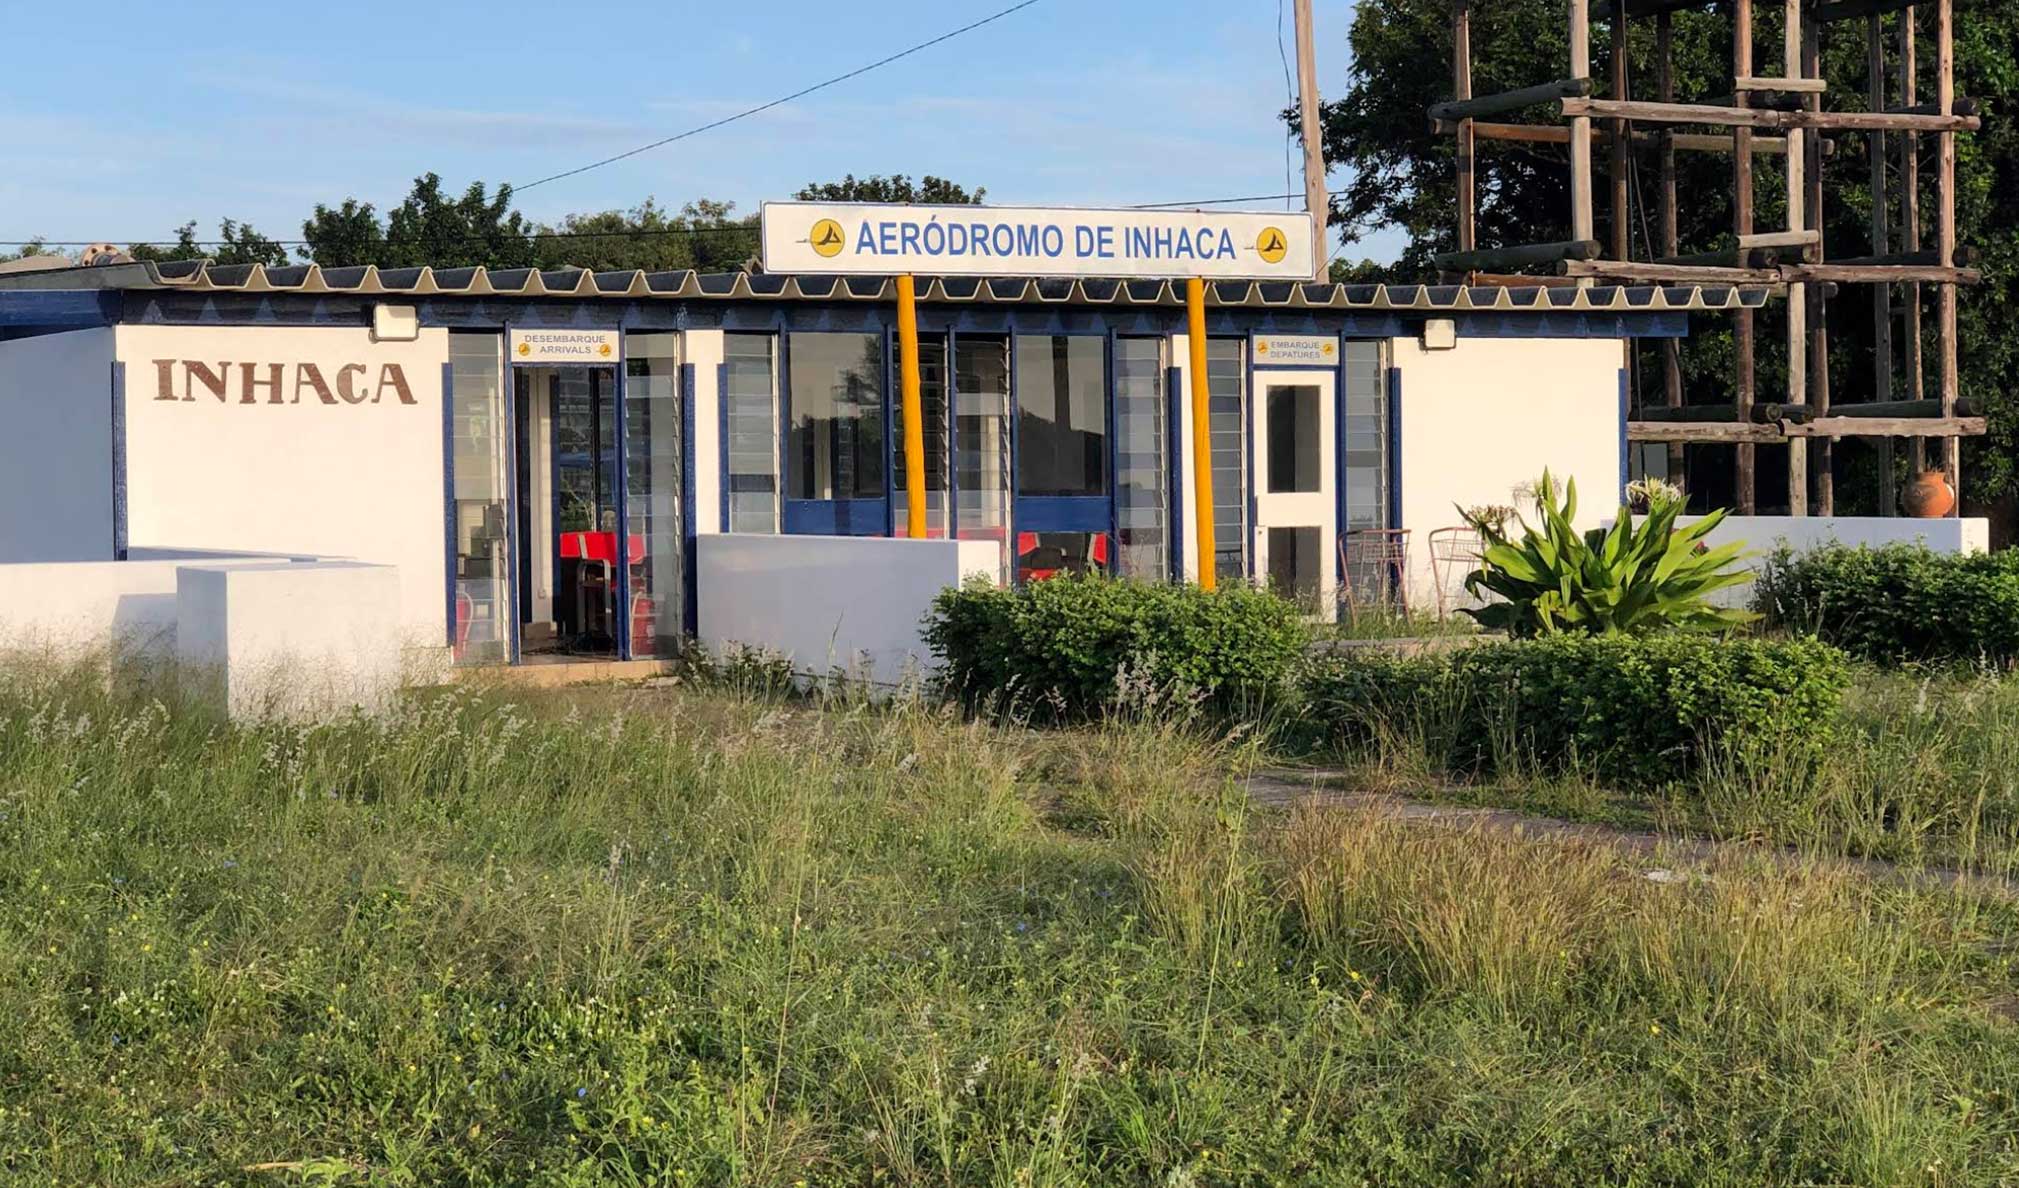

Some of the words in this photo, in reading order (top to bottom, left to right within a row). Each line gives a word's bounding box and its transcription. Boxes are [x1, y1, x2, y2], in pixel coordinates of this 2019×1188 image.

[855, 214, 1063, 258] AERÓDROMO
[1075, 226, 1114, 258] DE
[1125, 226, 1237, 260] INHACA
[524, 334, 606, 343] DESEMBARQUE
[540, 345, 592, 354] ARRIVALS
[1270, 341, 1321, 349] EMBARQUE
[1270, 351, 1321, 359] DEPATURES
[152, 359, 418, 405] INHACA
